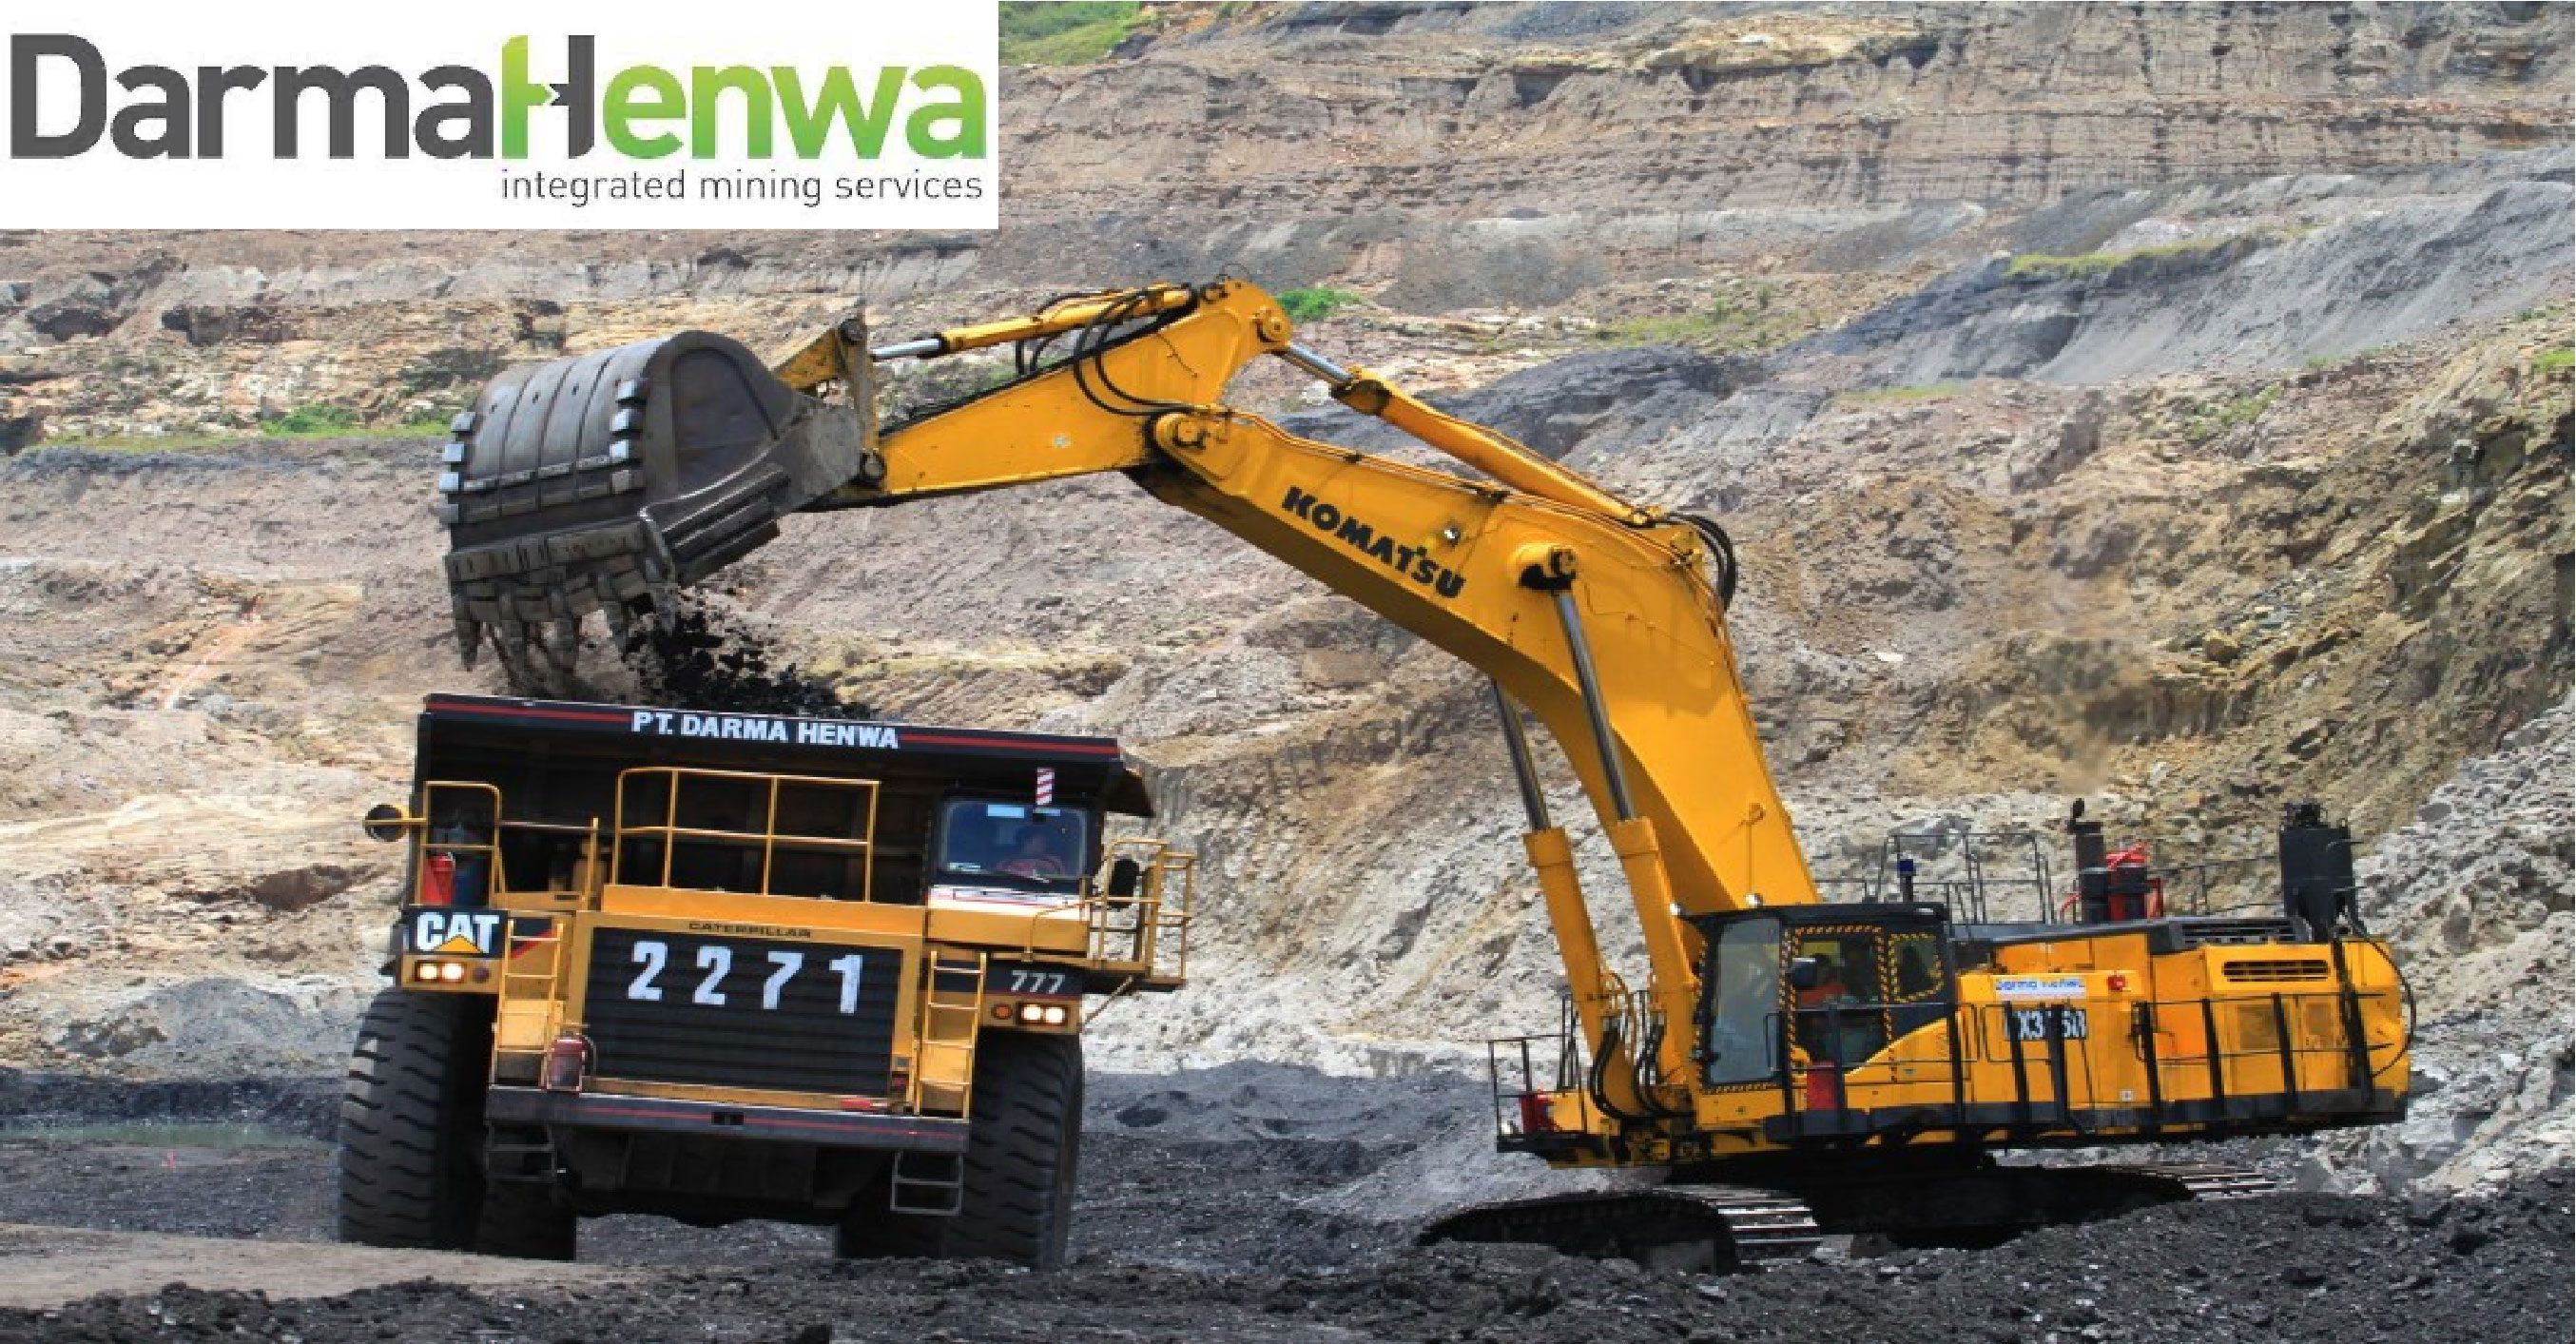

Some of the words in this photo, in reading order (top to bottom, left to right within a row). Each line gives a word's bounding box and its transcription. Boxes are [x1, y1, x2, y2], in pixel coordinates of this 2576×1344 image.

[1281, 486, 1466, 598] KOMATSU
[630, 711, 673, 736] PT.
[679, 713, 789, 743] DARMA
[796, 722, 900, 750] HENWA
[416, 910, 500, 954] CAT
[688, 922, 812, 939] CATERPILLAR
[626, 940, 863, 1015] 2271
[1010, 969, 1066, 994] 777
